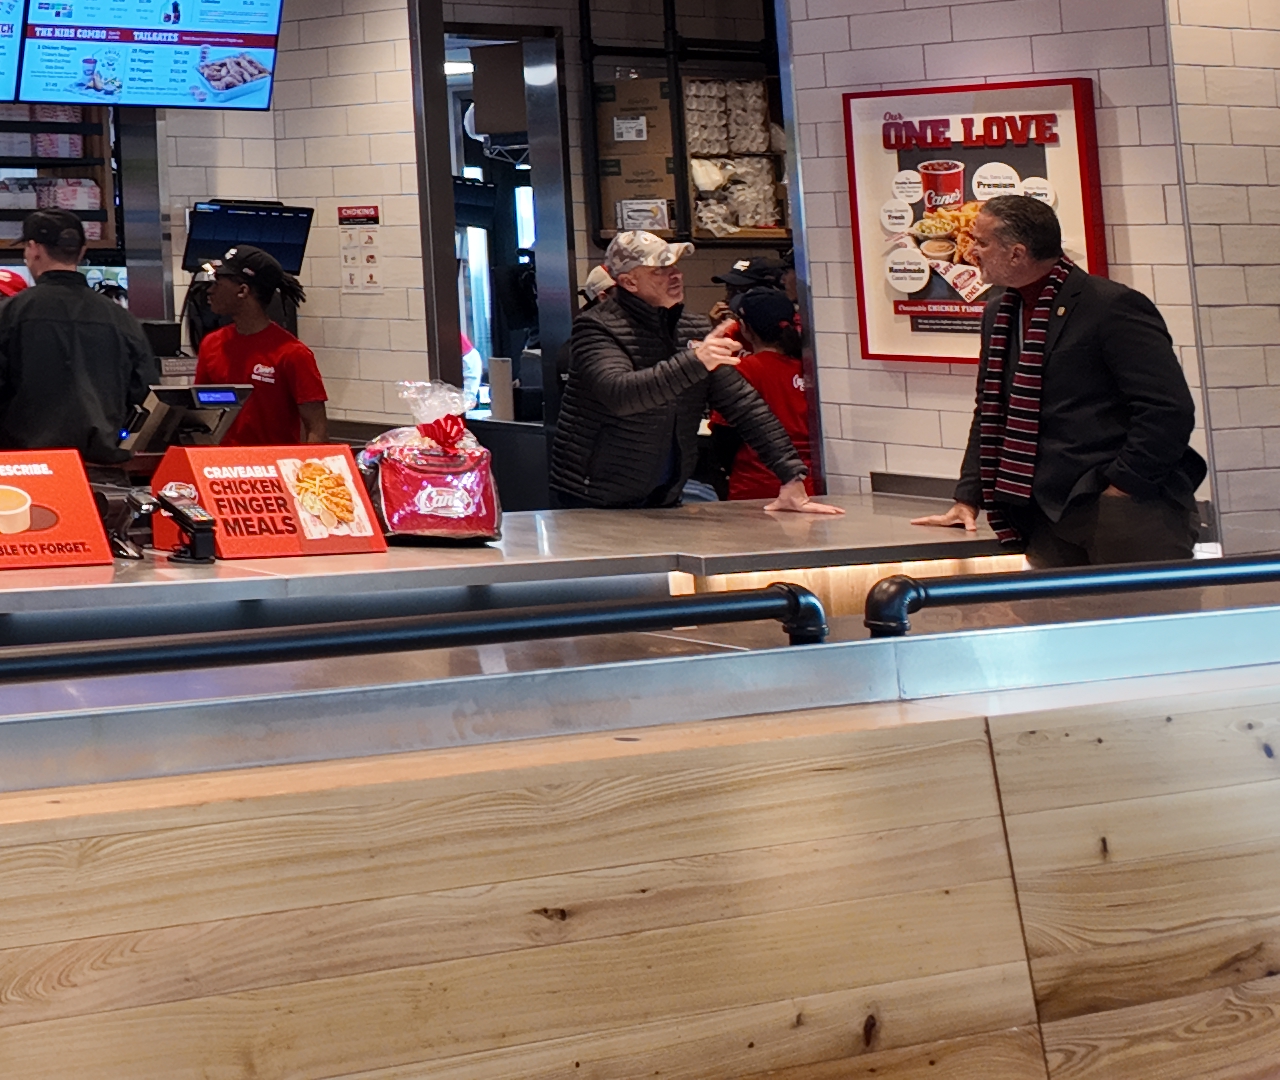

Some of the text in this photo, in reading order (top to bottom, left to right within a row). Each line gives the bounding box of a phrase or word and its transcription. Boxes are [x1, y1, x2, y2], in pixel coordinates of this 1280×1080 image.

[34, 27, 54, 37] THE
[76, 28, 107, 39] COMBO
[883, 111, 905, 122] Our
[882, 113, 1060, 151] ONE LOVE
[976, 181, 1016, 189] Premium
[924, 188, 962, 207] Cane's
[341, 207, 375, 216] CHOKING
[202, 465, 279, 480] CRAVEABLE
[209, 479, 284, 496] CHICKEN
[213, 496, 292, 516] FINGER
[222, 516, 298, 538] MEALS
[20, 543, 38, 556] TO
[40, 540, 92, 555] FORGET.
